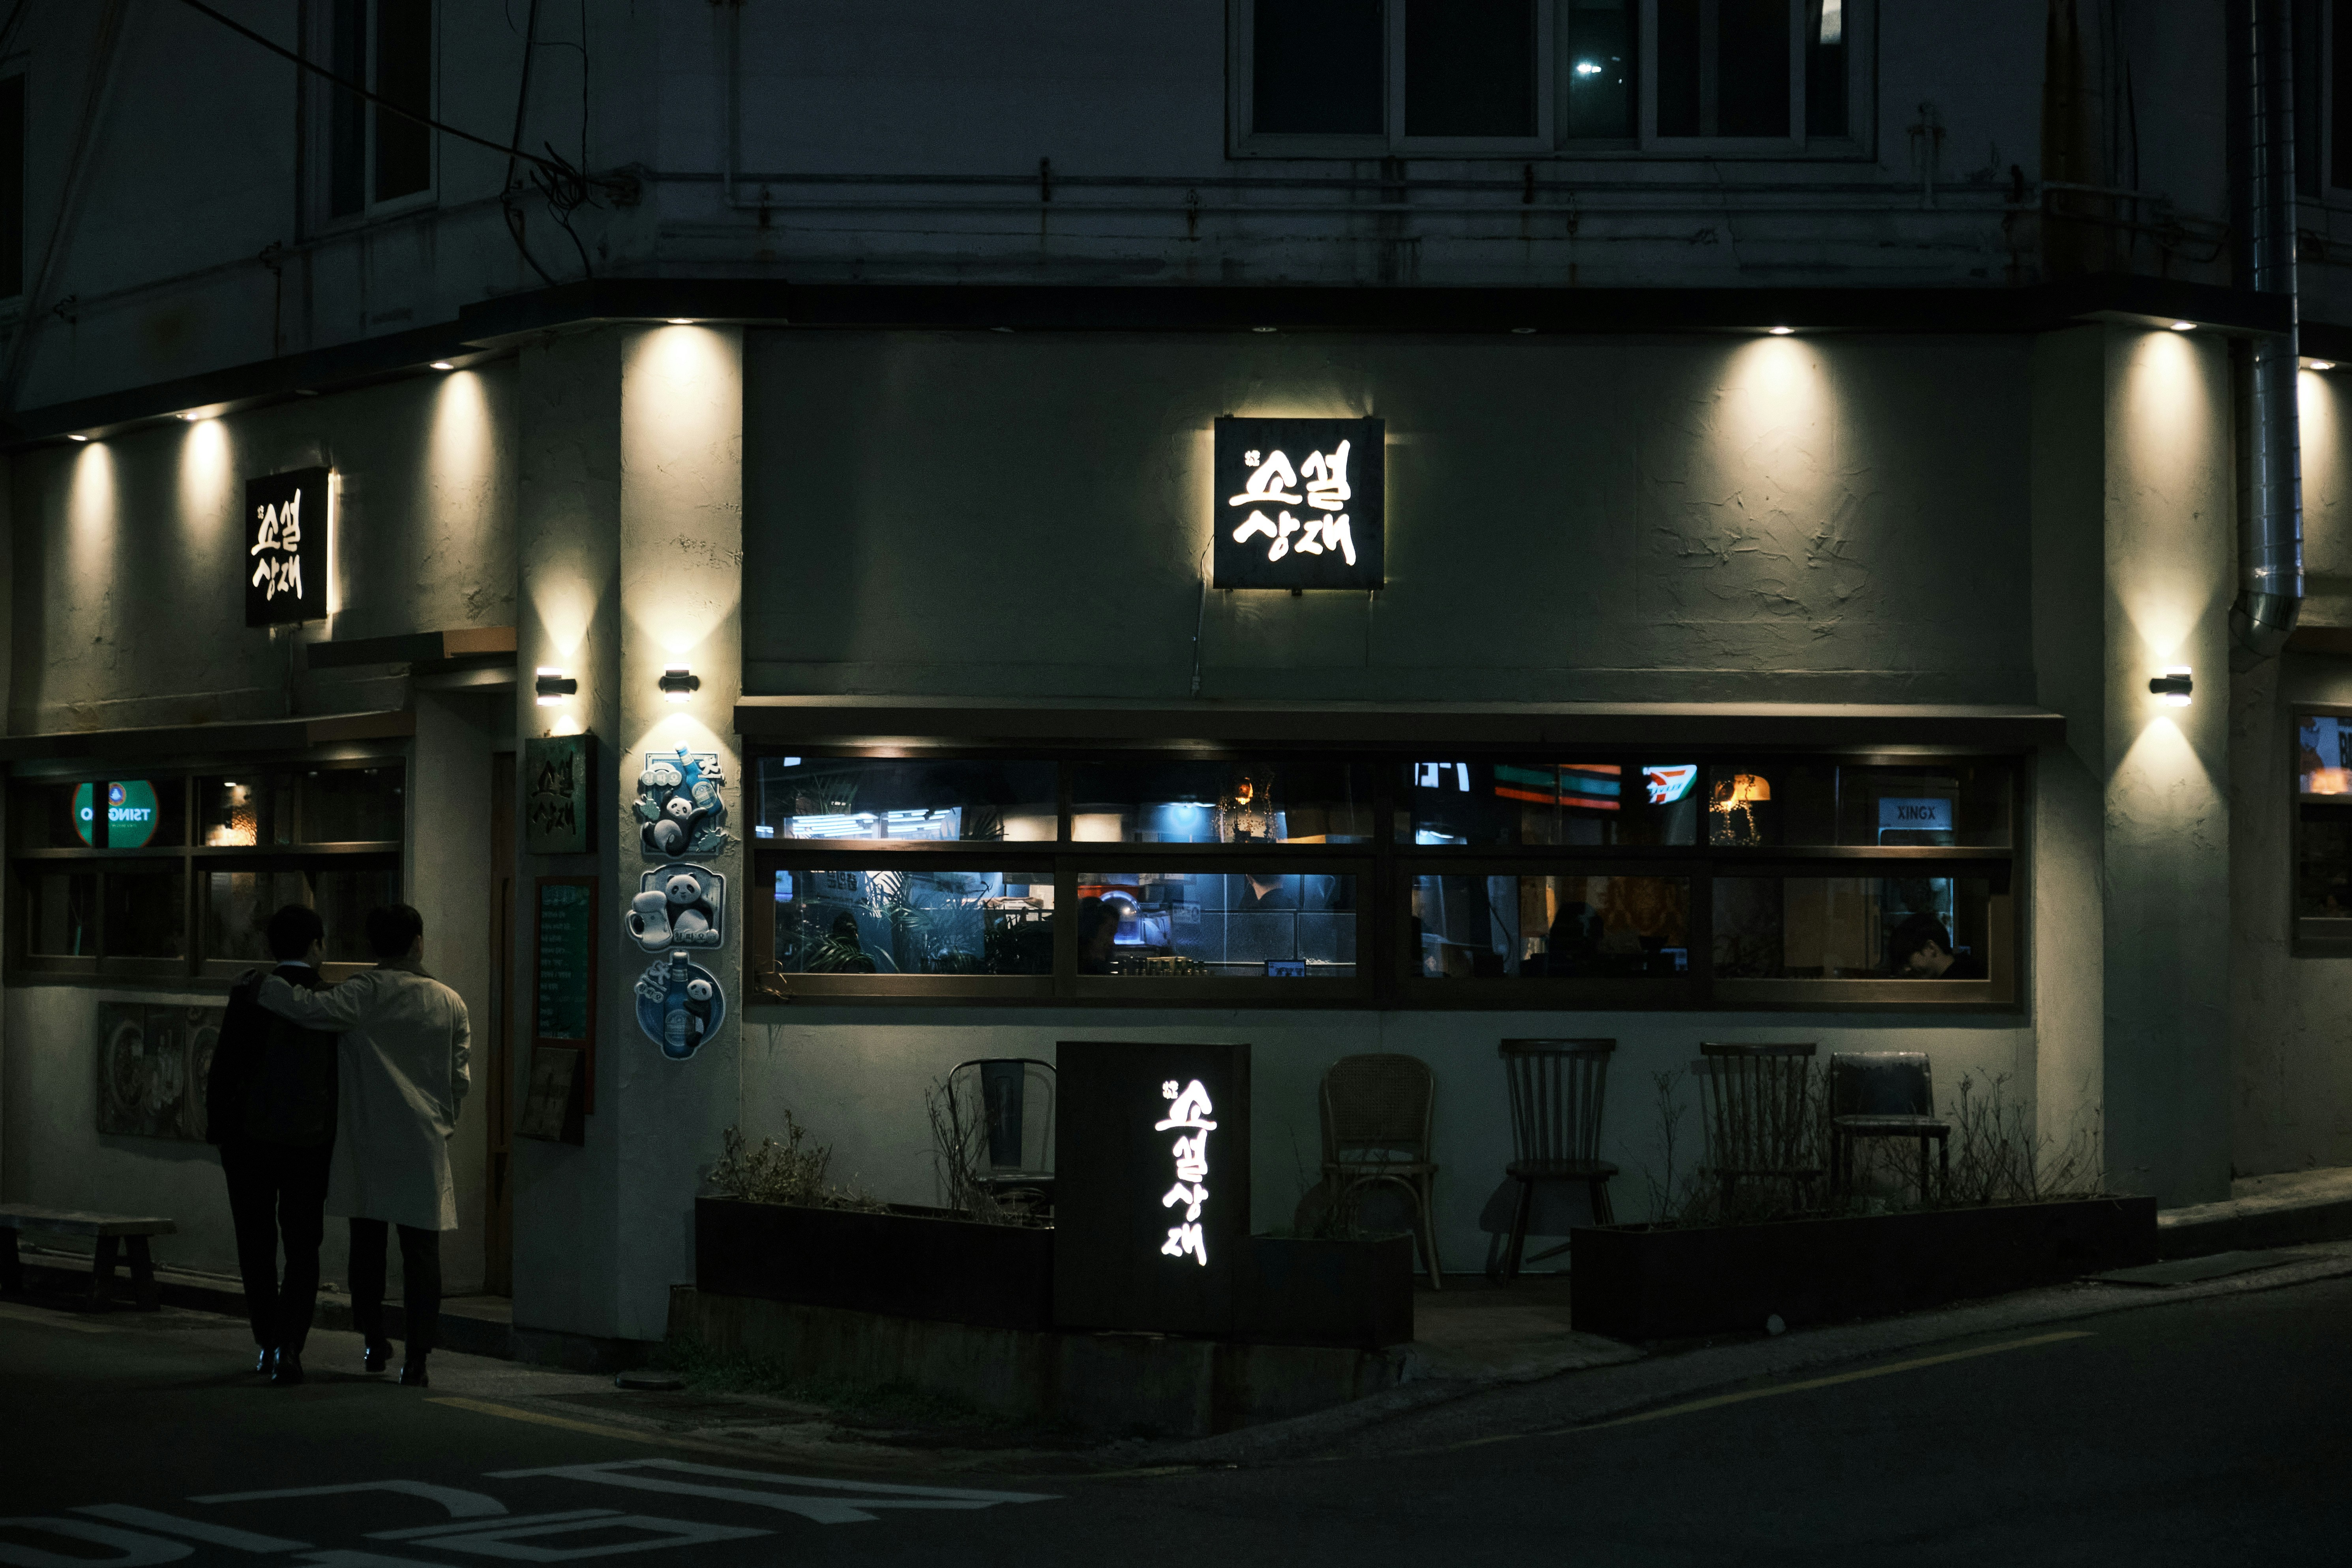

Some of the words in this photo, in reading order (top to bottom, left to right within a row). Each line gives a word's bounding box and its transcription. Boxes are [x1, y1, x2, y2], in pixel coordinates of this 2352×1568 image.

[1229, 440, 1351, 511] 소설
[251, 488, 300, 556] 소설
[1898, 806, 1935, 820] XINGX
